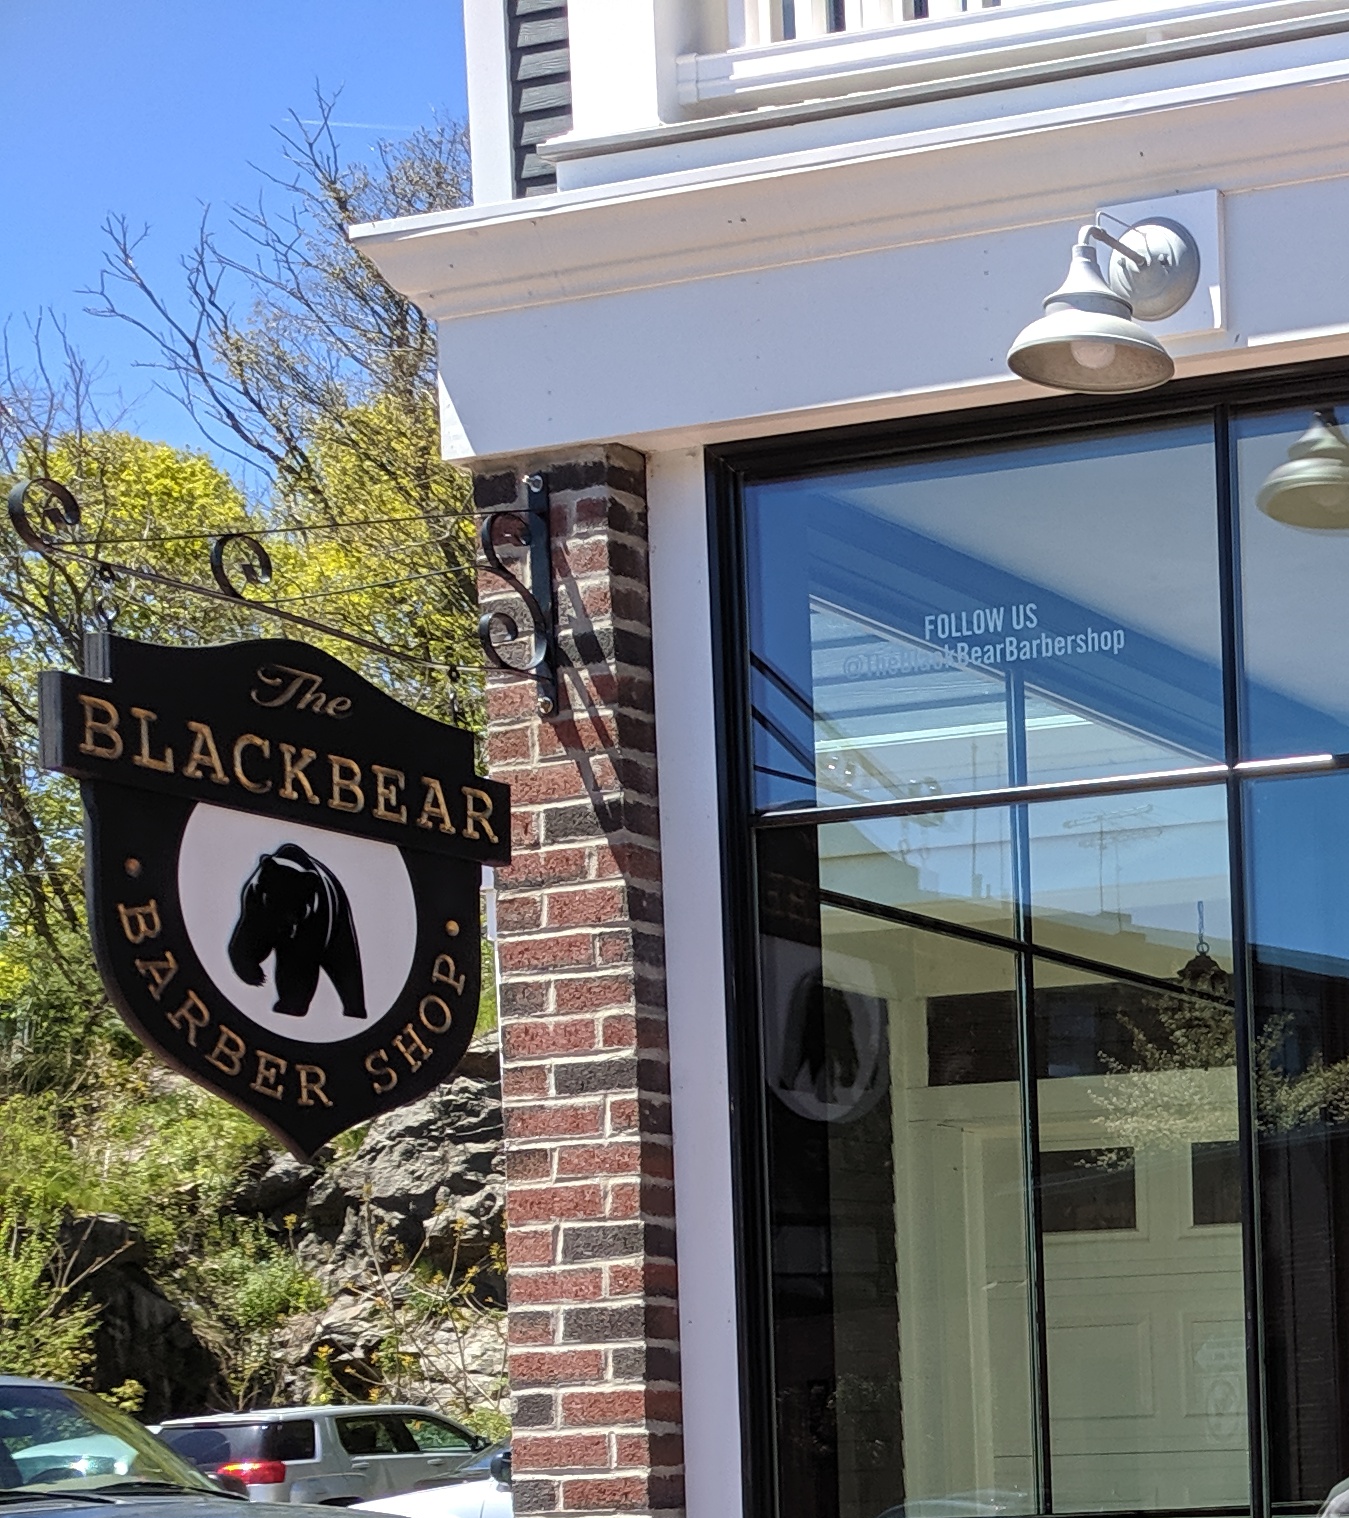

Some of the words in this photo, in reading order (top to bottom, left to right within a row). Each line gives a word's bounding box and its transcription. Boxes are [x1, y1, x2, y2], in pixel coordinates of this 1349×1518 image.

[925, 607, 1005, 640] FOLLOW
[1011, 603, 1038, 631] US
[250, 664, 352, 720] The
[78, 694, 500, 845] BLACKBEAR
[117, 898, 333, 1109] BARBER
[364, 955, 467, 1095] SHOP
